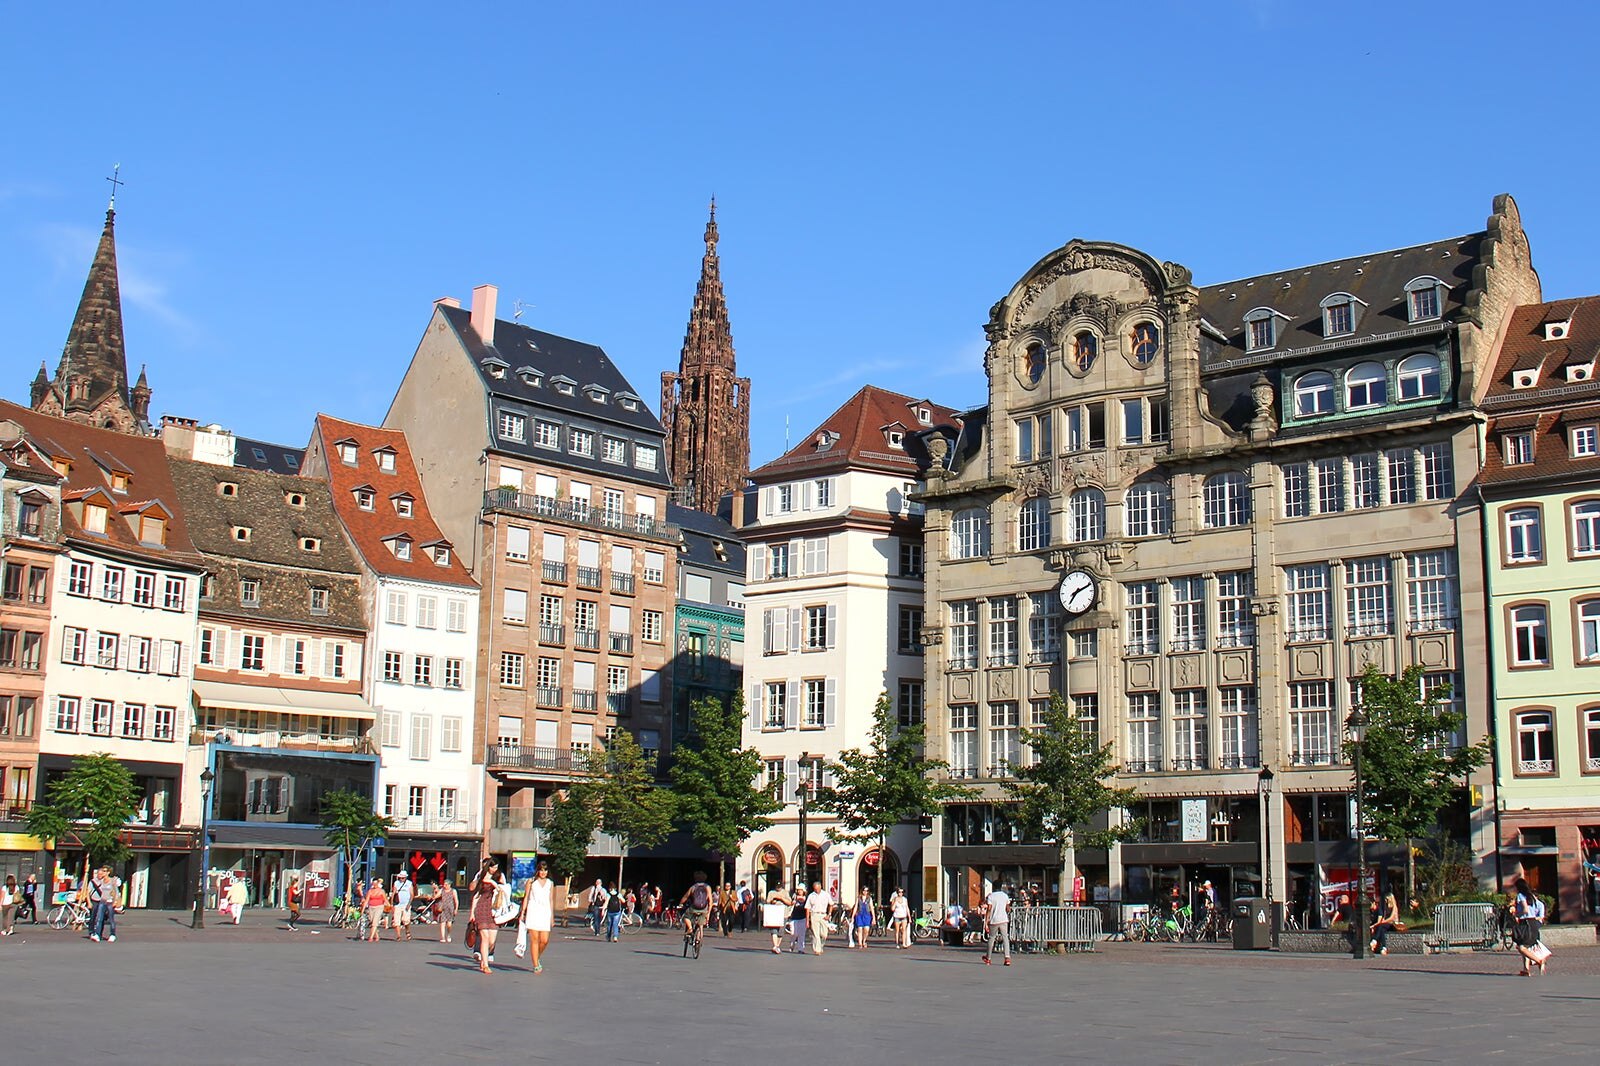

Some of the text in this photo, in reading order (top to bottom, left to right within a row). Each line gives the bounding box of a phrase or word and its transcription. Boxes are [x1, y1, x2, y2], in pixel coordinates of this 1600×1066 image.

[220, 870, 236, 880] SOL
[302, 871, 321, 882] SOL
[314, 878, 330, 888] DES
